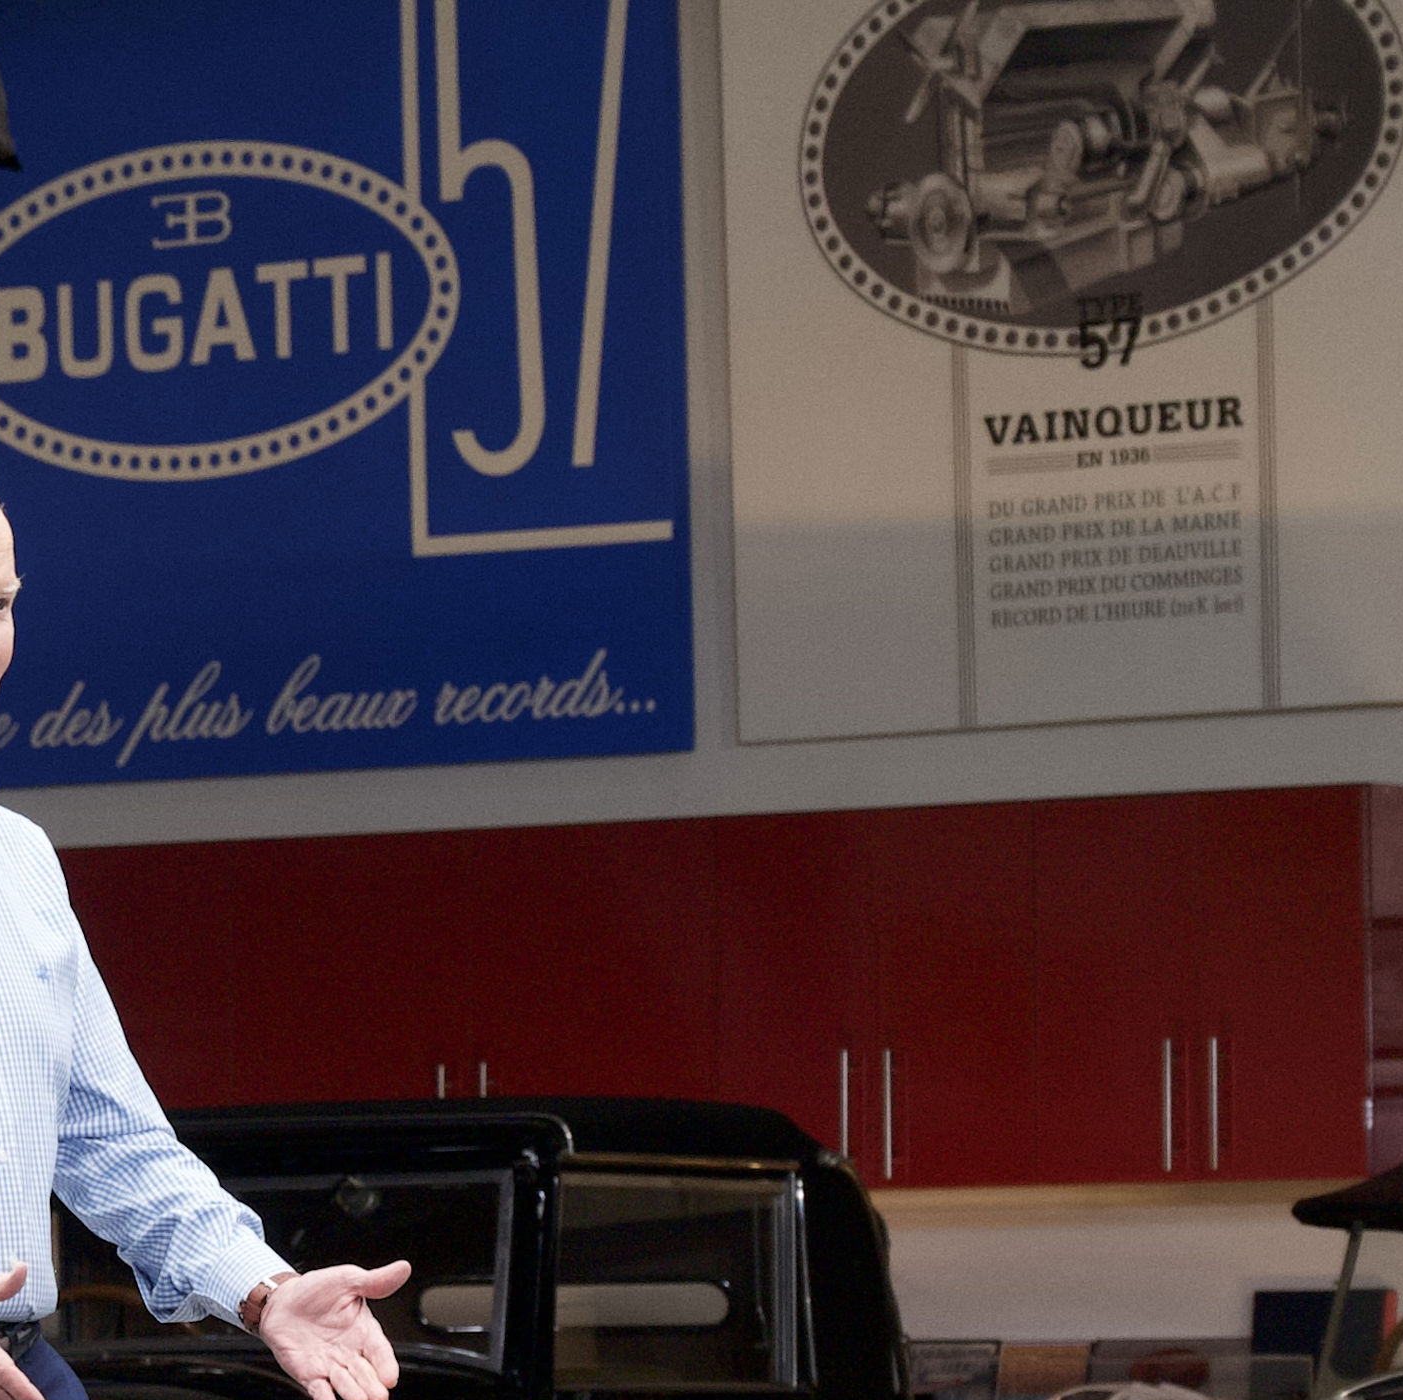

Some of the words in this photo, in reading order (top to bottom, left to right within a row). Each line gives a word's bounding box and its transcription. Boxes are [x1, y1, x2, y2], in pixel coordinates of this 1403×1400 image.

[1078, 316, 1141, 368] 57
[984, 396, 1244, 446] VAINQUEUR
[1077, 451, 1102, 469] EN
[1110, 447, 1150, 466] 1936
[989, 500, 1015, 520] DU
[1021, 496, 1087, 516] GRAND
[1095, 491, 1135, 512] PRIX
[1142, 489, 1166, 508] DE
[989, 524, 1056, 546] GRAND
[1062, 520, 1105, 543] PRIX
[1111, 518, 1135, 538] DE
[1142, 517, 1165, 537] LA
[1172, 511, 1241, 533] MARNE
[989, 552, 1055, 573] GRAND
[1061, 549, 1103, 569] PRIX
[1109, 547, 1132, 565] DE
[1138, 538, 1242, 563] DEAUVILLE
[990, 579, 1054, 601] GRAND
[1057, 577, 1096, 597] PRIX
[1101, 575, 1127, 594] DU
[1130, 566, 1244, 591] COMMINGES
[991, 607, 1062, 629] RECORD
[1066, 604, 1087, 623] DE
[1094, 600, 1167, 622] L'HEURE
[30, 679, 123, 749] des
[116, 659, 254, 768] plus
[266, 653, 418, 735] beaux
